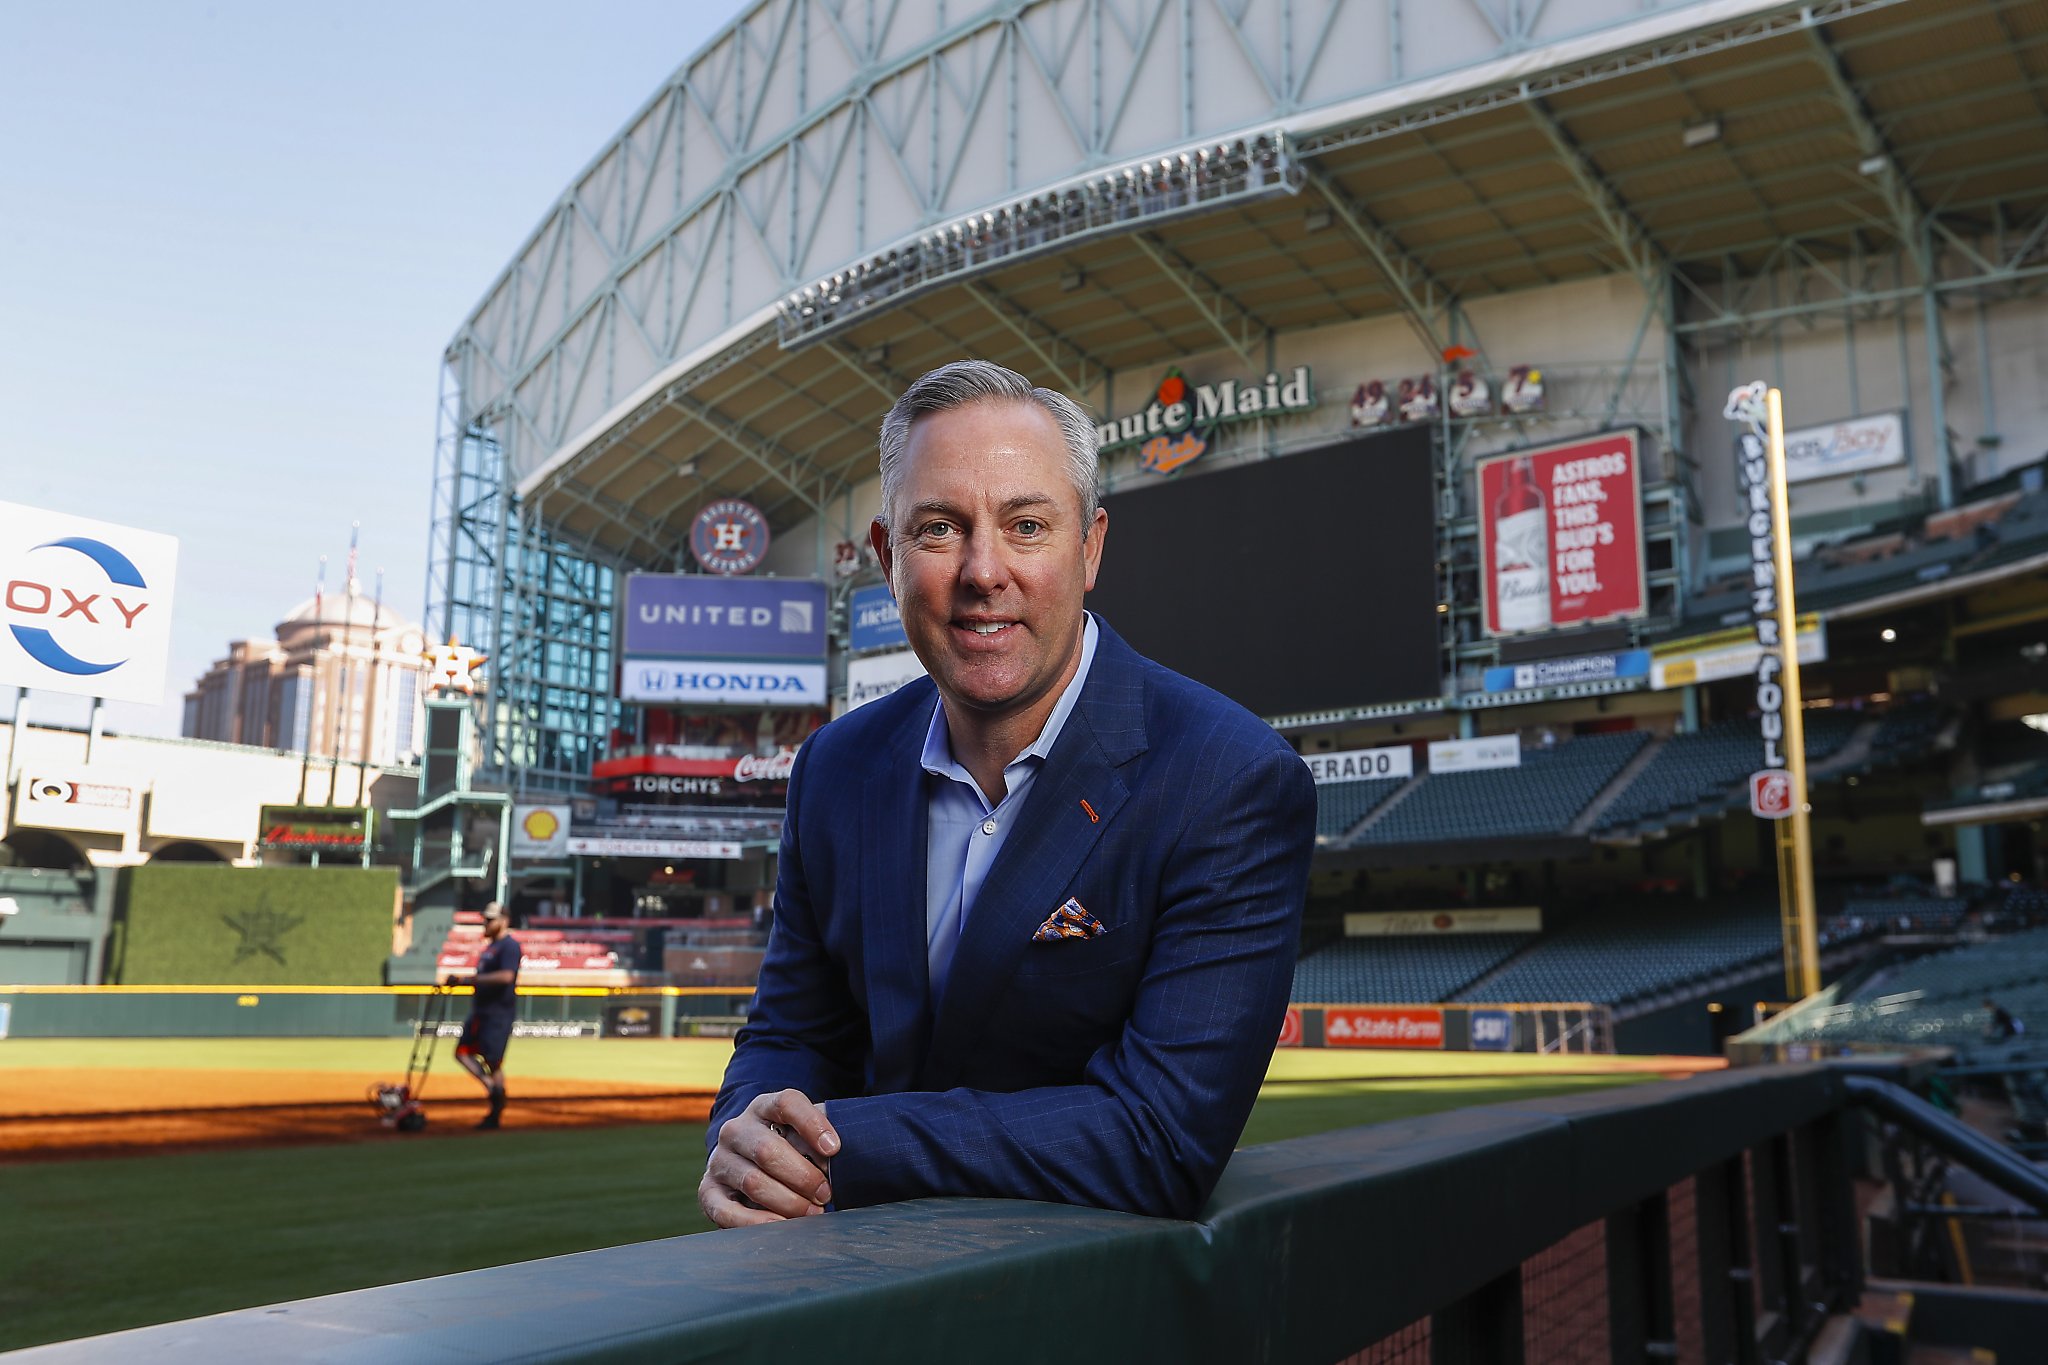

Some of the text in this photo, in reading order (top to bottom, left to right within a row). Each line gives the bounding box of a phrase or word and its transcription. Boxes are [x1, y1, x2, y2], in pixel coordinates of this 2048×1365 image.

[1194, 367, 1309, 421] Maid
[1552, 452, 1627, 484] ASTROS
[1554, 503, 1599, 529] THIS
[714, 523, 744, 550] H
[1555, 522, 1615, 552] BUD'S
[702, 552, 756, 572] ASTROS
[1557, 548, 1596, 574] FOR
[1557, 571, 1604, 596] YOU.
[6, 580, 149, 629] OXY
[640, 604, 773, 626] UNITED
[429, 644, 475, 690] H
[674, 673, 807, 692] HONDA
[1757, 656, 1785, 768] FOUL
[1311, 754, 1391, 780] ERADO
[633, 776, 721, 795] TORCHYS
